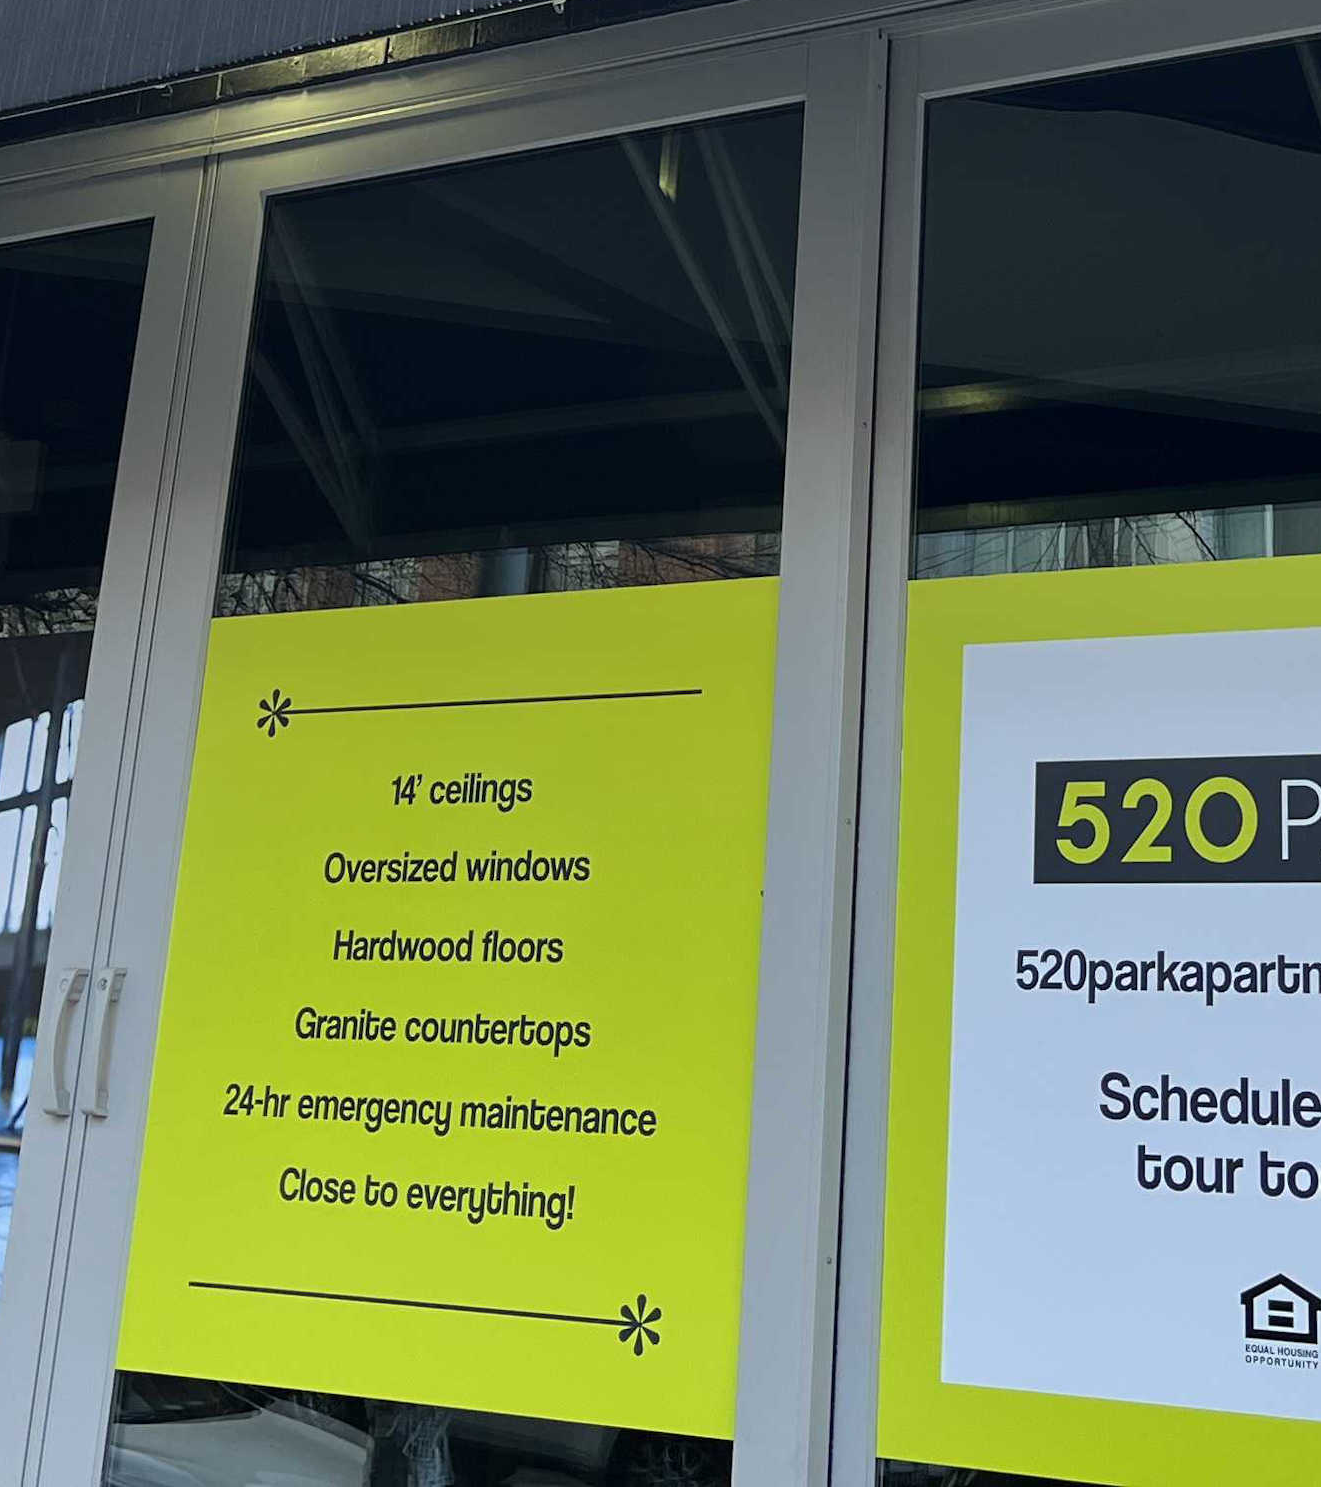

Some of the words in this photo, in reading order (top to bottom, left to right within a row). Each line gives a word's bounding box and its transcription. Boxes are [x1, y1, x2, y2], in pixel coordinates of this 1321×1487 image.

[429, 772, 533, 813] ceilings
[1056, 776, 1258, 864] 520
[324, 851, 458, 883] Oversized
[465, 850, 591, 882] windows
[333, 930, 474, 962] Hardwood
[481, 930, 564, 963] floors
[294, 1007, 396, 1041] Granite
[404, 1013, 592, 1058] countertops
[223, 1083, 290, 1119] 24-hr
[297, 1095, 452, 1137] emergency
[459, 1096, 657, 1137] maintenance
[1099, 1071, 1321, 1129] Schedule
[1137, 1144, 1244, 1194] tour
[279, 1167, 356, 1205] Close
[363, 1174, 398, 1208] to
[406, 1181, 576, 1231] everything!
[1245, 1344, 1275, 1355] EQUAL
[1277, 1347, 1319, 1359] HOUSING
[1245, 1354, 1319, 1369] OPPORTUNITY
